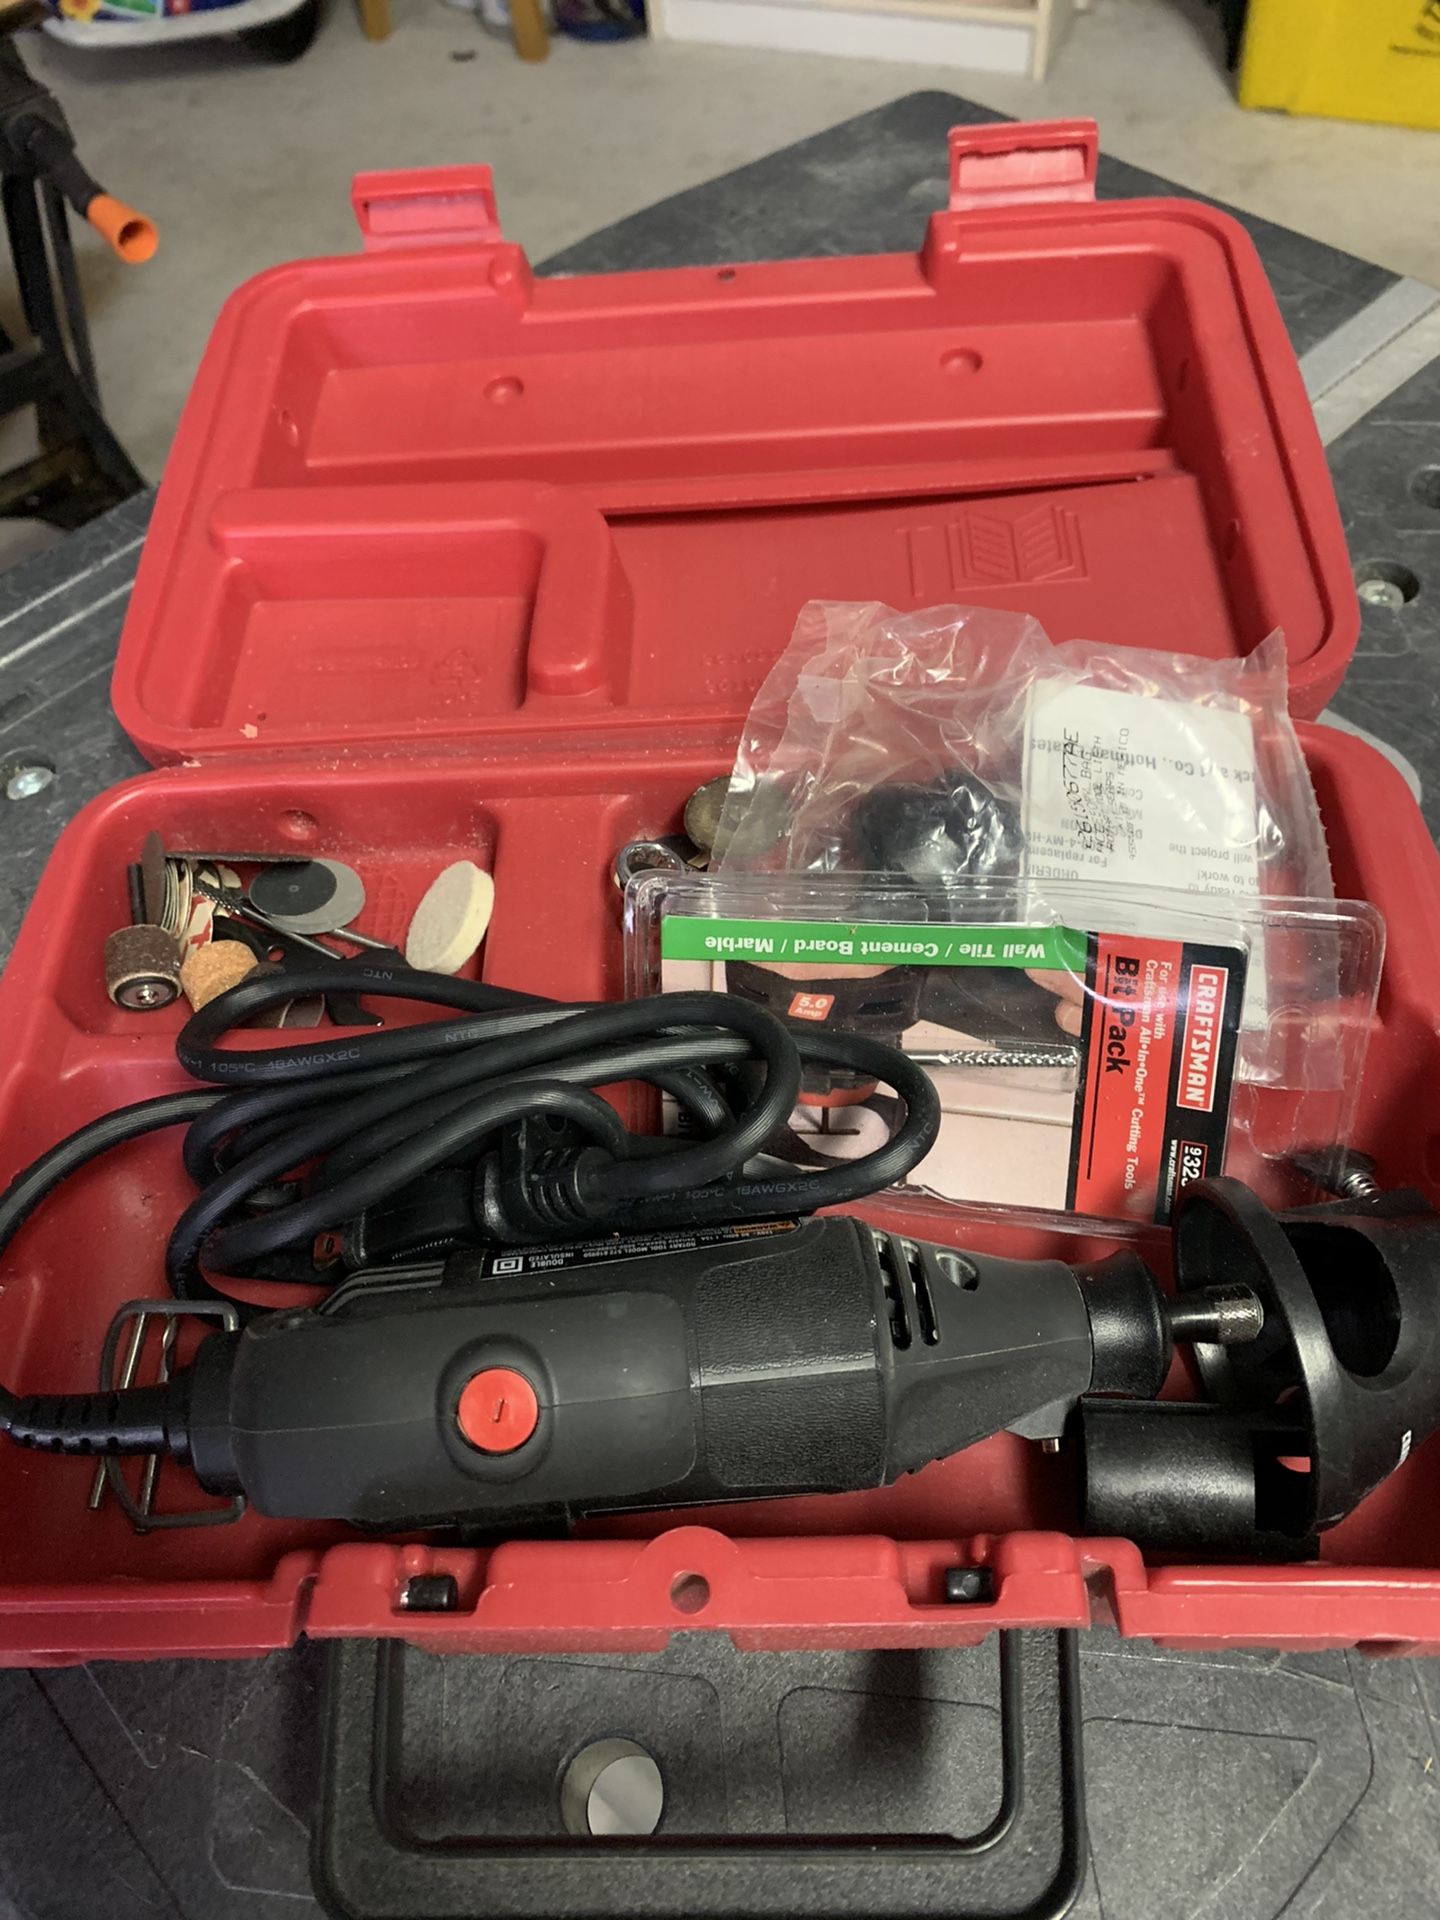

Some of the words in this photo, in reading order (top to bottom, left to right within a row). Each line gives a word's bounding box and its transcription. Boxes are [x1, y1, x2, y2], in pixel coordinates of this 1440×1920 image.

[1168, 842, 1188, 857] the
[1191, 846, 1230, 862] project
[1233, 852, 1254, 866] will
[1089, 855, 1108, 868] For
[1233, 874, 1245, 886] to
[704, 935, 774, 954] Marble
[780, 938, 788, 955] /
[794, 938, 854, 956] Board
[859, 939, 940, 958] Cement
[944, 942, 953, 959] /
[959, 940, 995, 959] Tile
[1002, 941, 1046, 960] Wall
[1112, 957, 1140, 995] Bit
[1158, 961, 1172, 984] For
[1142, 959, 1157, 1023] Craftsman
[1156, 985, 1170, 1009] use
[795, 1006, 823, 1018] Amp
[799, 996, 828, 1009] 5.0
[1153, 1013, 1168, 1040] with
[1105, 1008, 1136, 1075] Pack
[1184, 972, 1219, 1103] CRAFTSMAN
[1126, 1107, 1143, 1153] Cutting
[1123, 1156, 1140, 1190] Tools
[528, 1251, 575, 1262] INSULATED
[529, 1257, 565, 1268] DOUBLE
